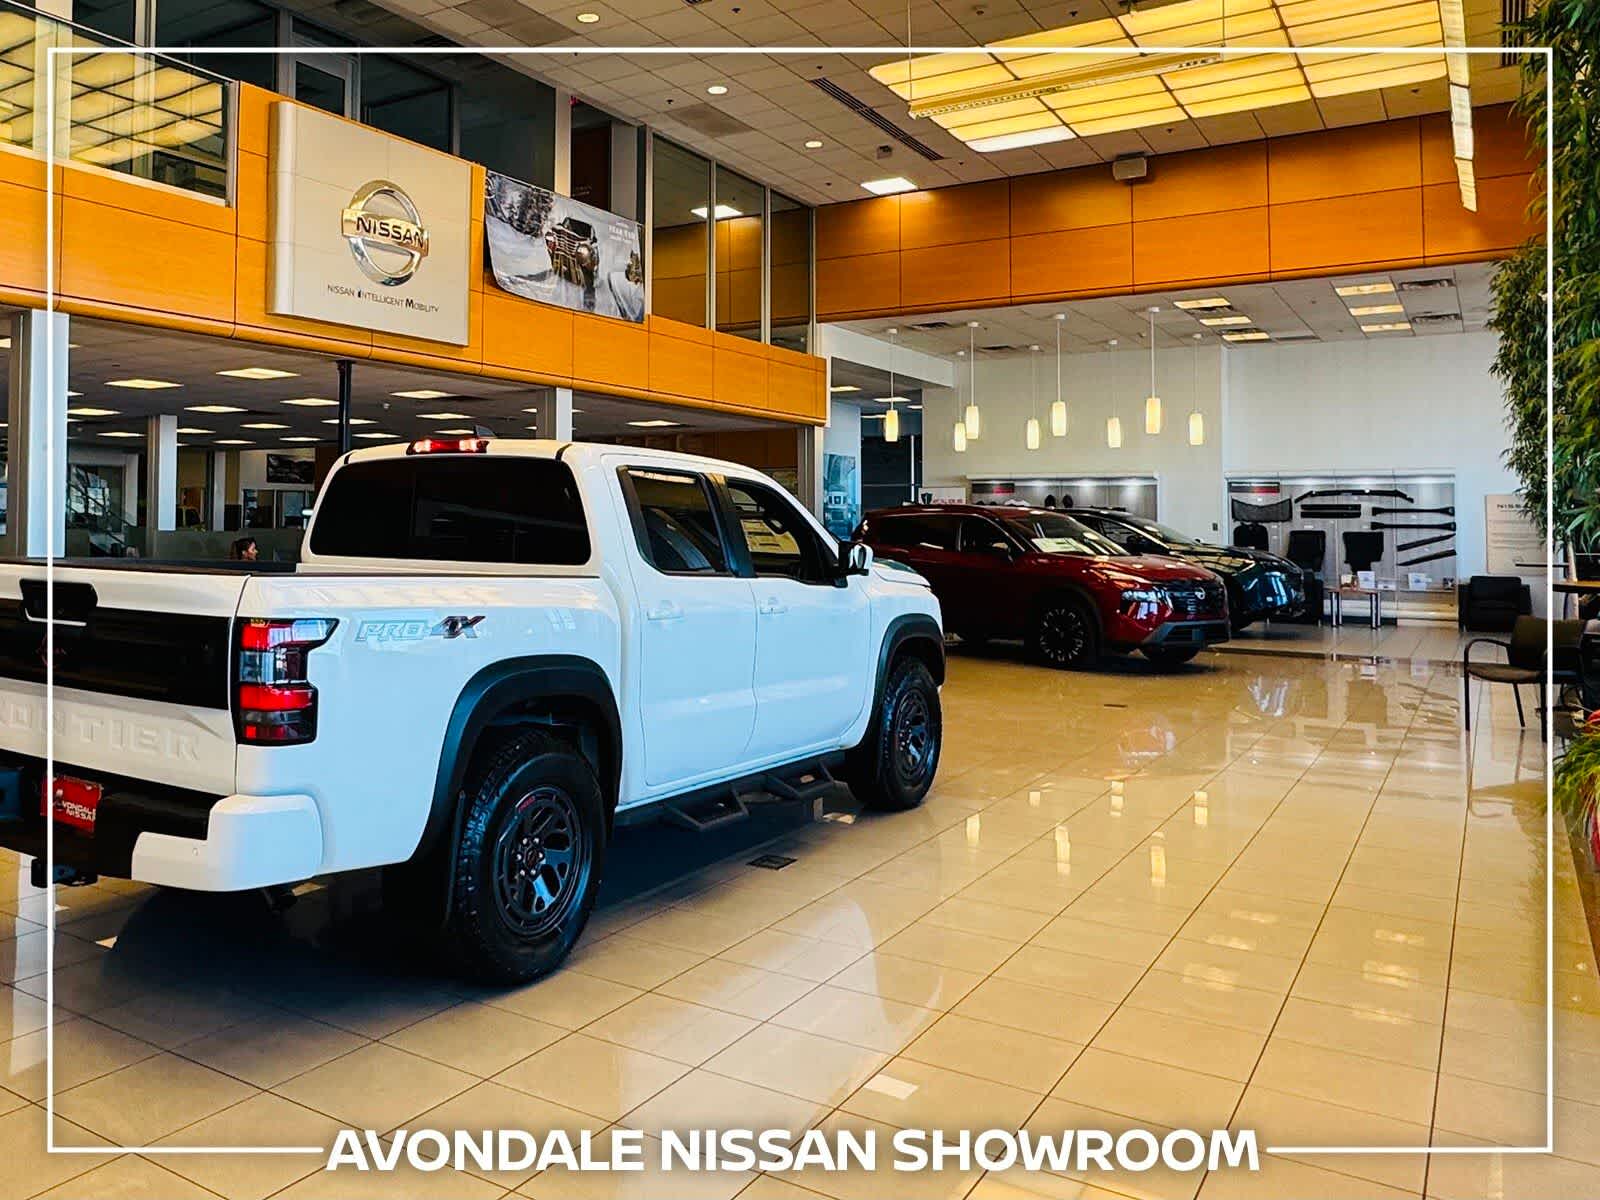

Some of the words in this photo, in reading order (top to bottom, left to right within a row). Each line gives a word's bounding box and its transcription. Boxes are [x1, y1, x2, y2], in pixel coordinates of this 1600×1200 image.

[356, 216, 424, 248] NISSAN
[327, 284, 355, 297] NISSAN
[357, 289, 404, 306] INTELLIGENT
[405, 298, 440, 313] MOBILITY
[0, 700, 201, 762] ONTIER
